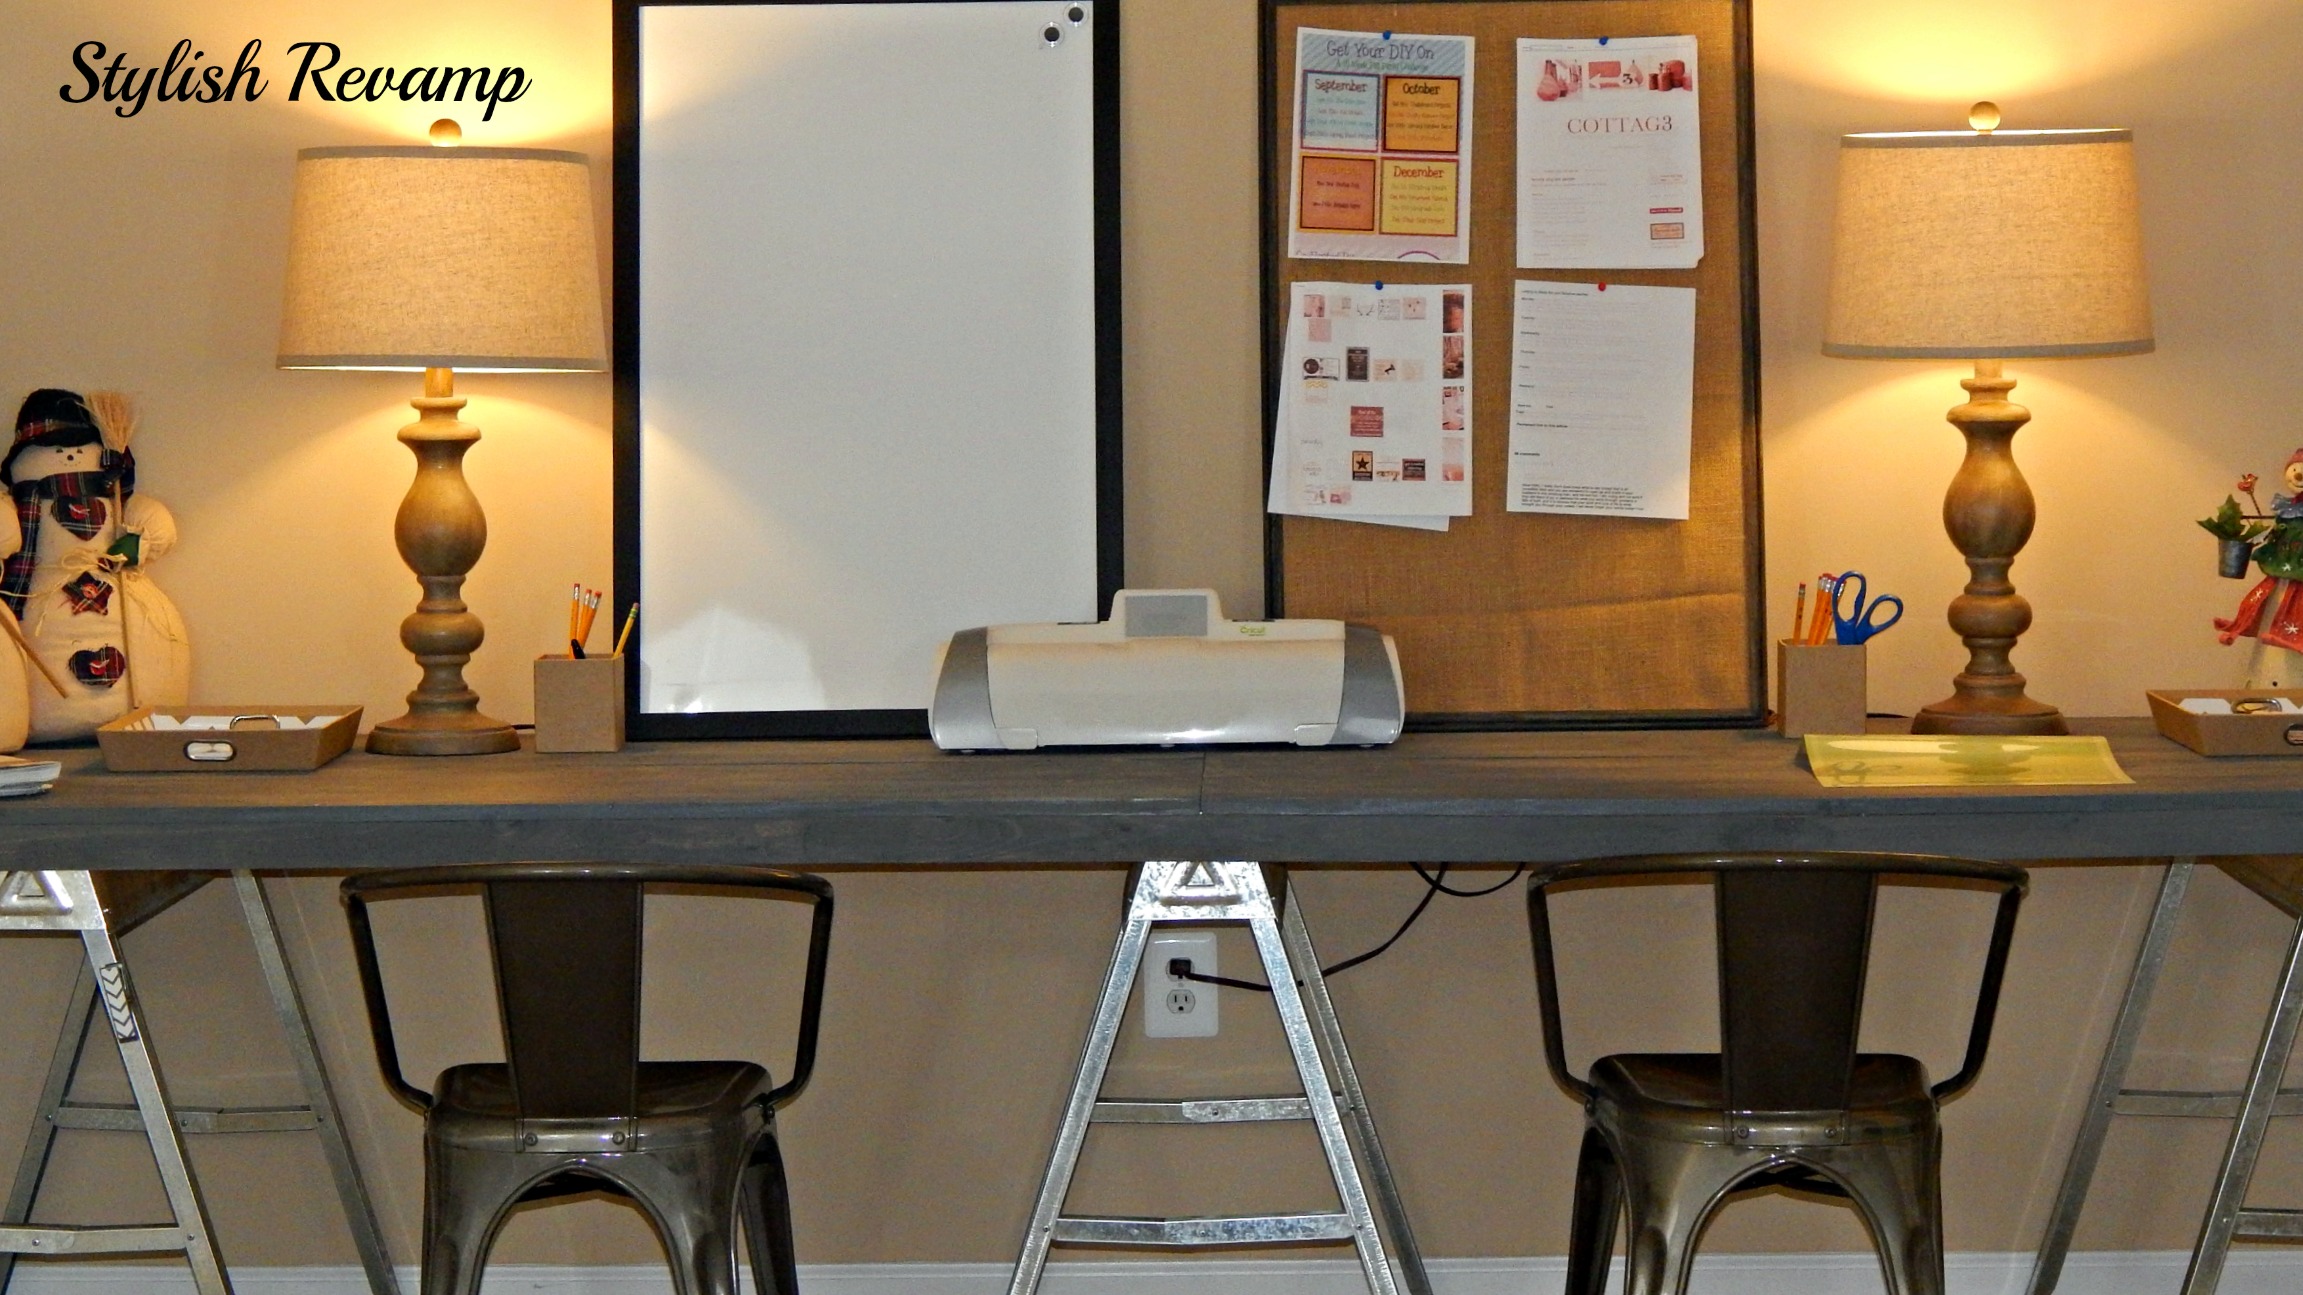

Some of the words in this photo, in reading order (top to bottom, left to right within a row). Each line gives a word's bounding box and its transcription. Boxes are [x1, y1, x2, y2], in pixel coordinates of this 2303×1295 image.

[1326, 40, 1348, 57] Get
[1354, 43, 1385, 59] Your
[1389, 44, 1414, 60] DIY
[1417, 45, 1435, 60] On
[1314, 78, 1368, 94] September
[1402, 82, 1441, 95] October
[1567, 116, 1673, 134] COTTAG3
[1393, 165, 1445, 179] December
